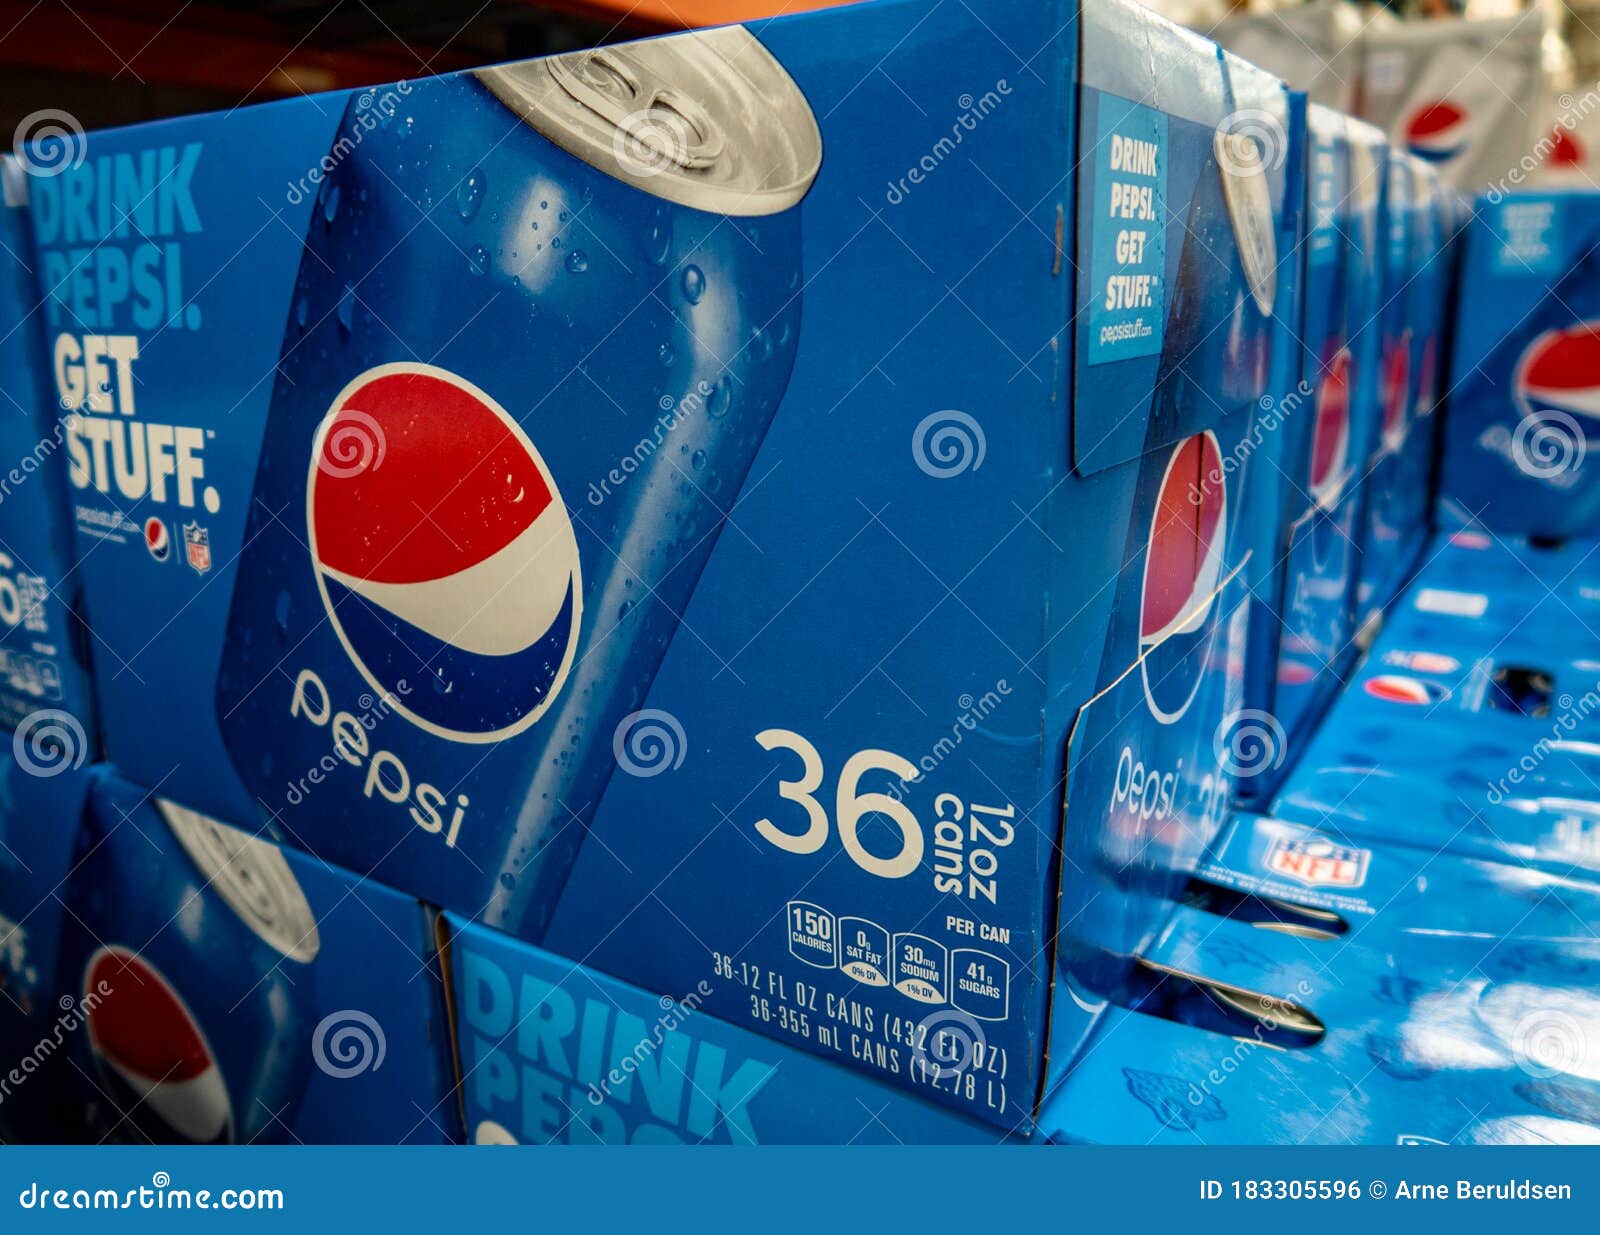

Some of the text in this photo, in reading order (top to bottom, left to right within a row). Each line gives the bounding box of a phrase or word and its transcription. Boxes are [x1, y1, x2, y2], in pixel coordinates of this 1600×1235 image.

[1110, 134, 1157, 177] DRINK
[28, 142, 203, 246] DRINK
[1110, 182, 1154, 221] PEPSI.
[1116, 229, 1146, 264] GET
[44, 243, 202, 331] PEPSI.
[1105, 274, 1152, 311] STUFF.
[54, 333, 139, 416] GET
[66, 414, 220, 513] STUFF.
[290, 669, 469, 848] pepsi
[754, 728, 924, 879] 36
[1109, 746, 1183, 835] pepsi
[934, 792, 964, 896] cans
[968, 803, 1015, 905] 12oz
[1280, 852, 1357, 883] NFL
[792, 931, 832, 954] CALORIES
[793, 907, 831, 940] 150
[946, 915, 1010, 944] PER CAN
[846, 944, 882, 965] SAT FAT
[852, 964, 864, 976] 0%
[900, 962, 939, 983] SODIUM
[904, 944, 936, 970] 30mg
[906, 983, 921, 995] 1%
[959, 978, 1000, 999] SUGARS
[713, 952, 1007, 1078] 36-12 FL OZ CANS (432 FL OZ)
[462, 949, 778, 1145] DRINK
[750, 995, 1006, 1113] 36-355 mL CANS (12.78 L)
[474, 1035, 688, 1145] PEP
